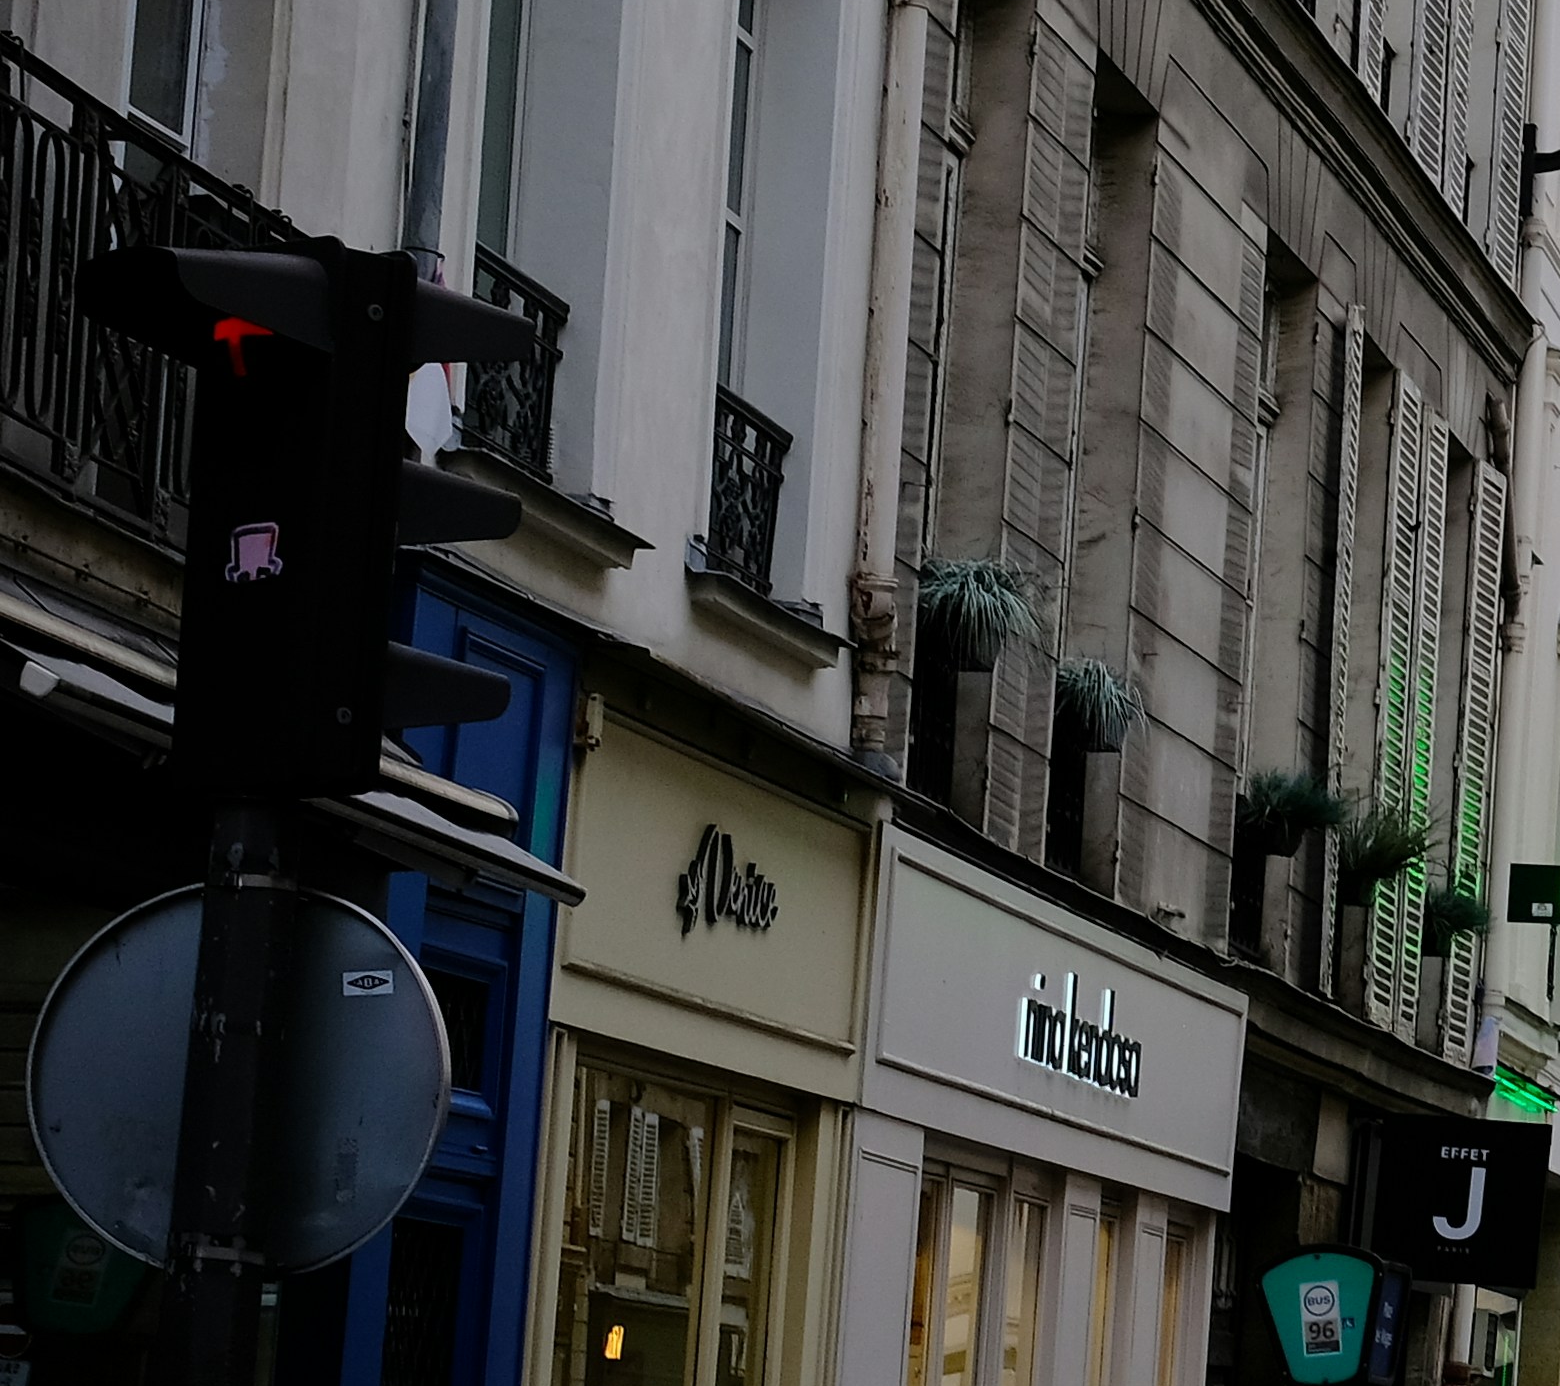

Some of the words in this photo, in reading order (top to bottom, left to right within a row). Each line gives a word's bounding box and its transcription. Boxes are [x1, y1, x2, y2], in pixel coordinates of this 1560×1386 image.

[1016, 973, 1065, 1071] nina
[1062, 971, 1142, 1098] kendosa
[1440, 1146, 1490, 1162] EFFET
[1432, 1166, 1487, 1241] J
[1307, 1296, 1331, 1306] BUS
[1308, 1321, 1335, 1340] 96
